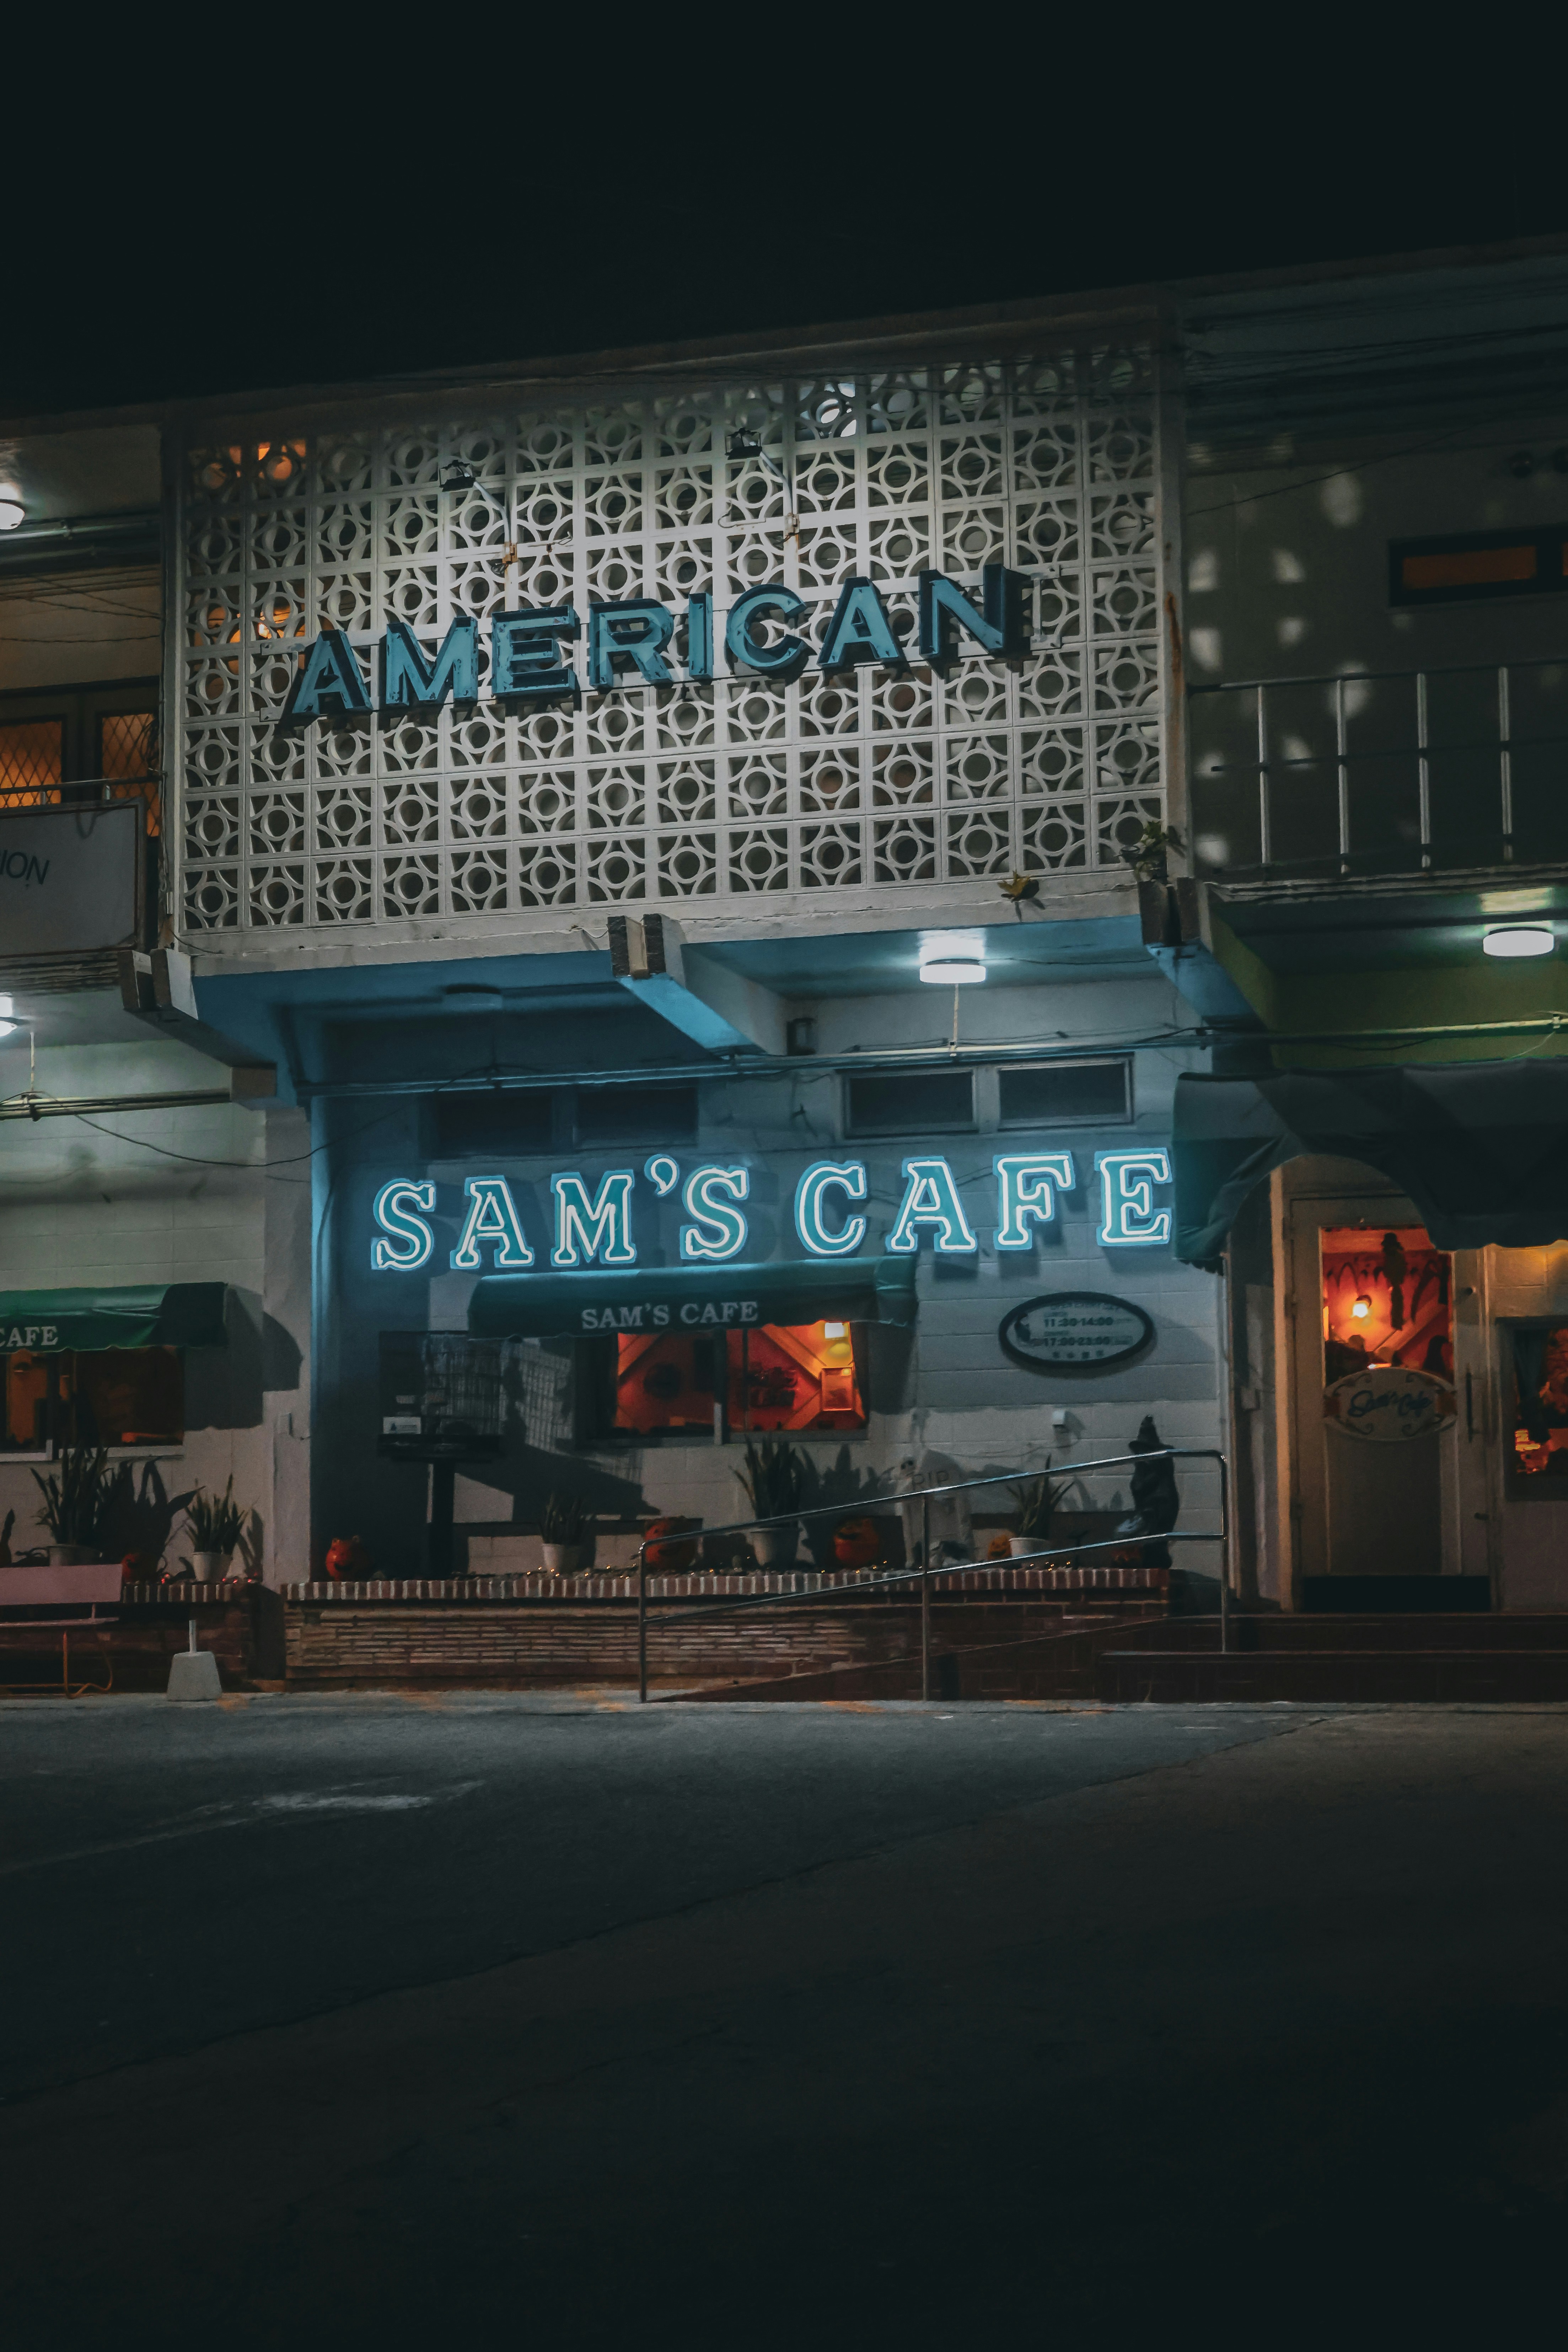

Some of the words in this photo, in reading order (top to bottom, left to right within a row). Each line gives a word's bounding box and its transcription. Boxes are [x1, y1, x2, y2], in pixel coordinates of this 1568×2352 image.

[291, 564, 1005, 714] AMERICAN
[371, 1154, 749, 1271] SAM'S
[795, 1148, 1172, 1254] CAFE
[581, 1303, 669, 1329] SAM'S
[680, 1301, 758, 1323] CAFE
